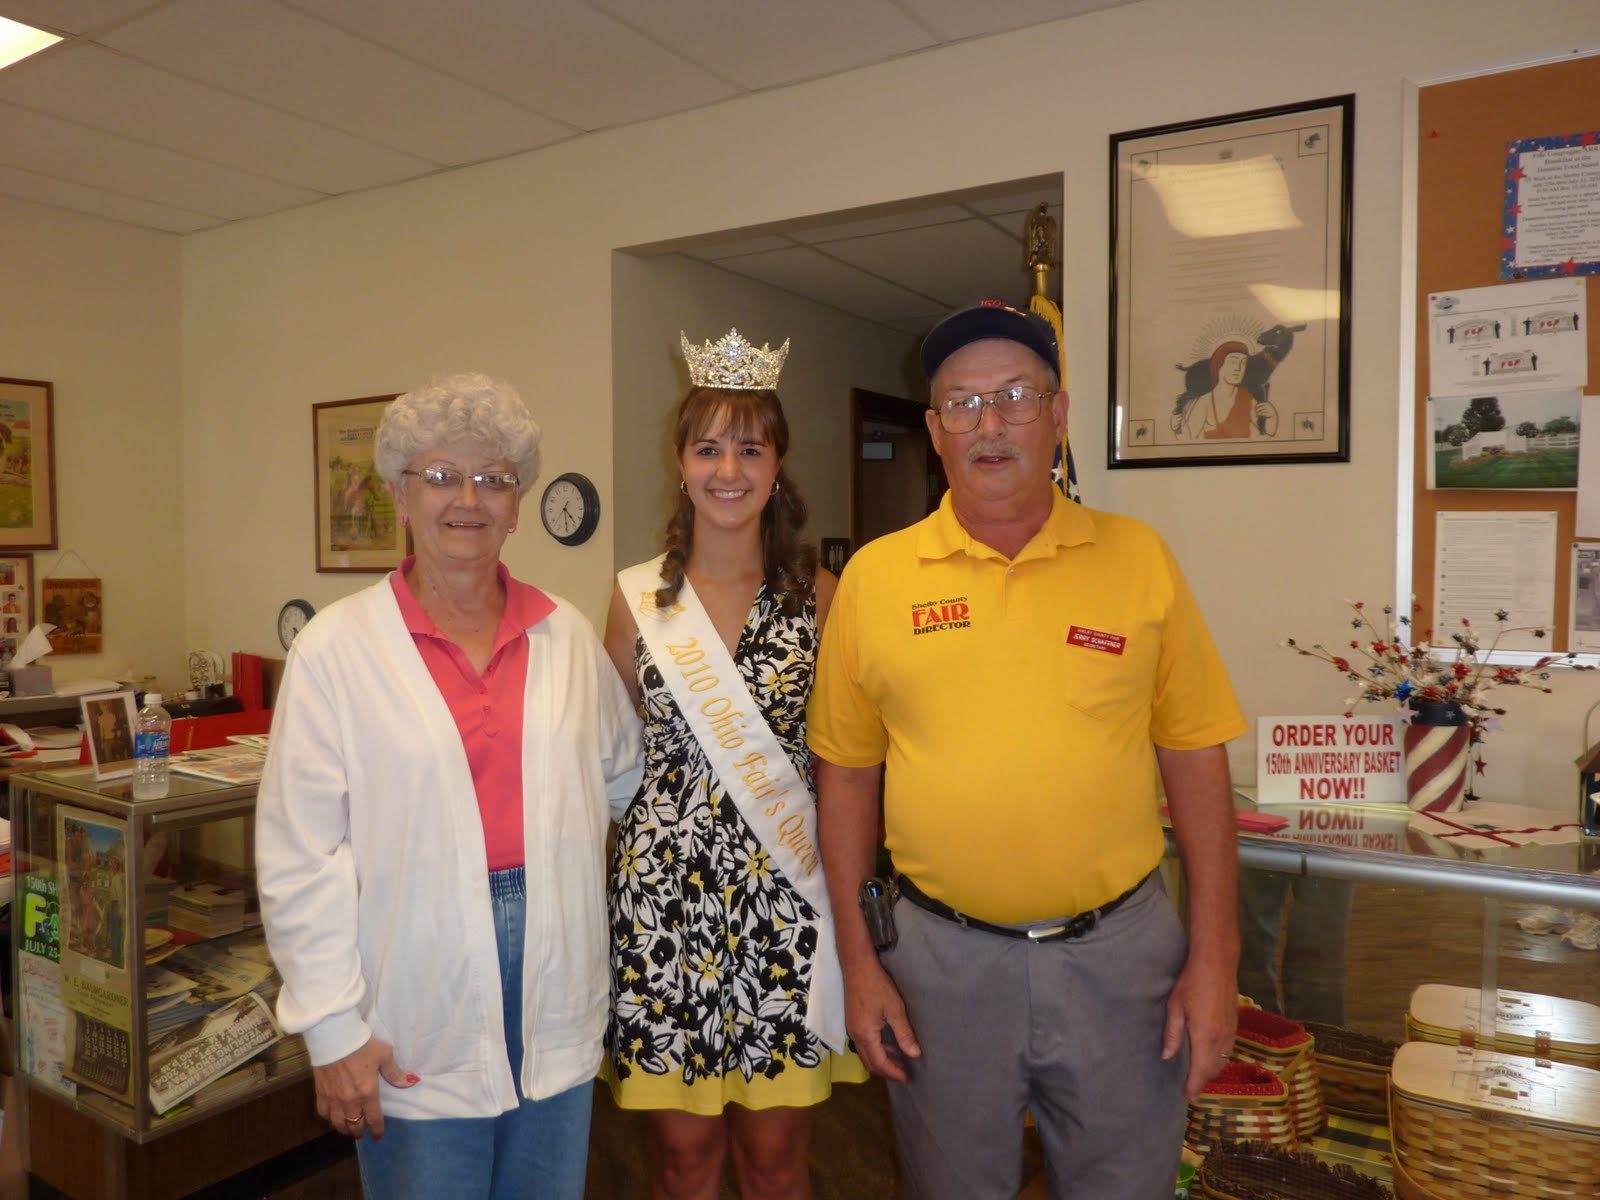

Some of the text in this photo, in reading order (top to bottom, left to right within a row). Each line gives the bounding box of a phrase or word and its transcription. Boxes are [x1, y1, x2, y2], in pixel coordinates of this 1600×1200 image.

[912, 596, 967, 610] Shelby County
[912, 603, 970, 627] FAIR
[913, 621, 971, 635] DIRECTOR
[1272, 723, 1395, 747] ORDER YOUR
[666, 637, 819, 877] 2010 Ohio Fair's Queen
[1266, 751, 1401, 775] 150th ANNIVERSARY BASKET
[1300, 777, 1366, 800] NOW!!
[26, 876, 47, 893] 150th
[25, 939, 47, 955] JULY
[215, 1026, 261, 1058] YEARLING
[187, 1054, 216, 1076] SHOW
